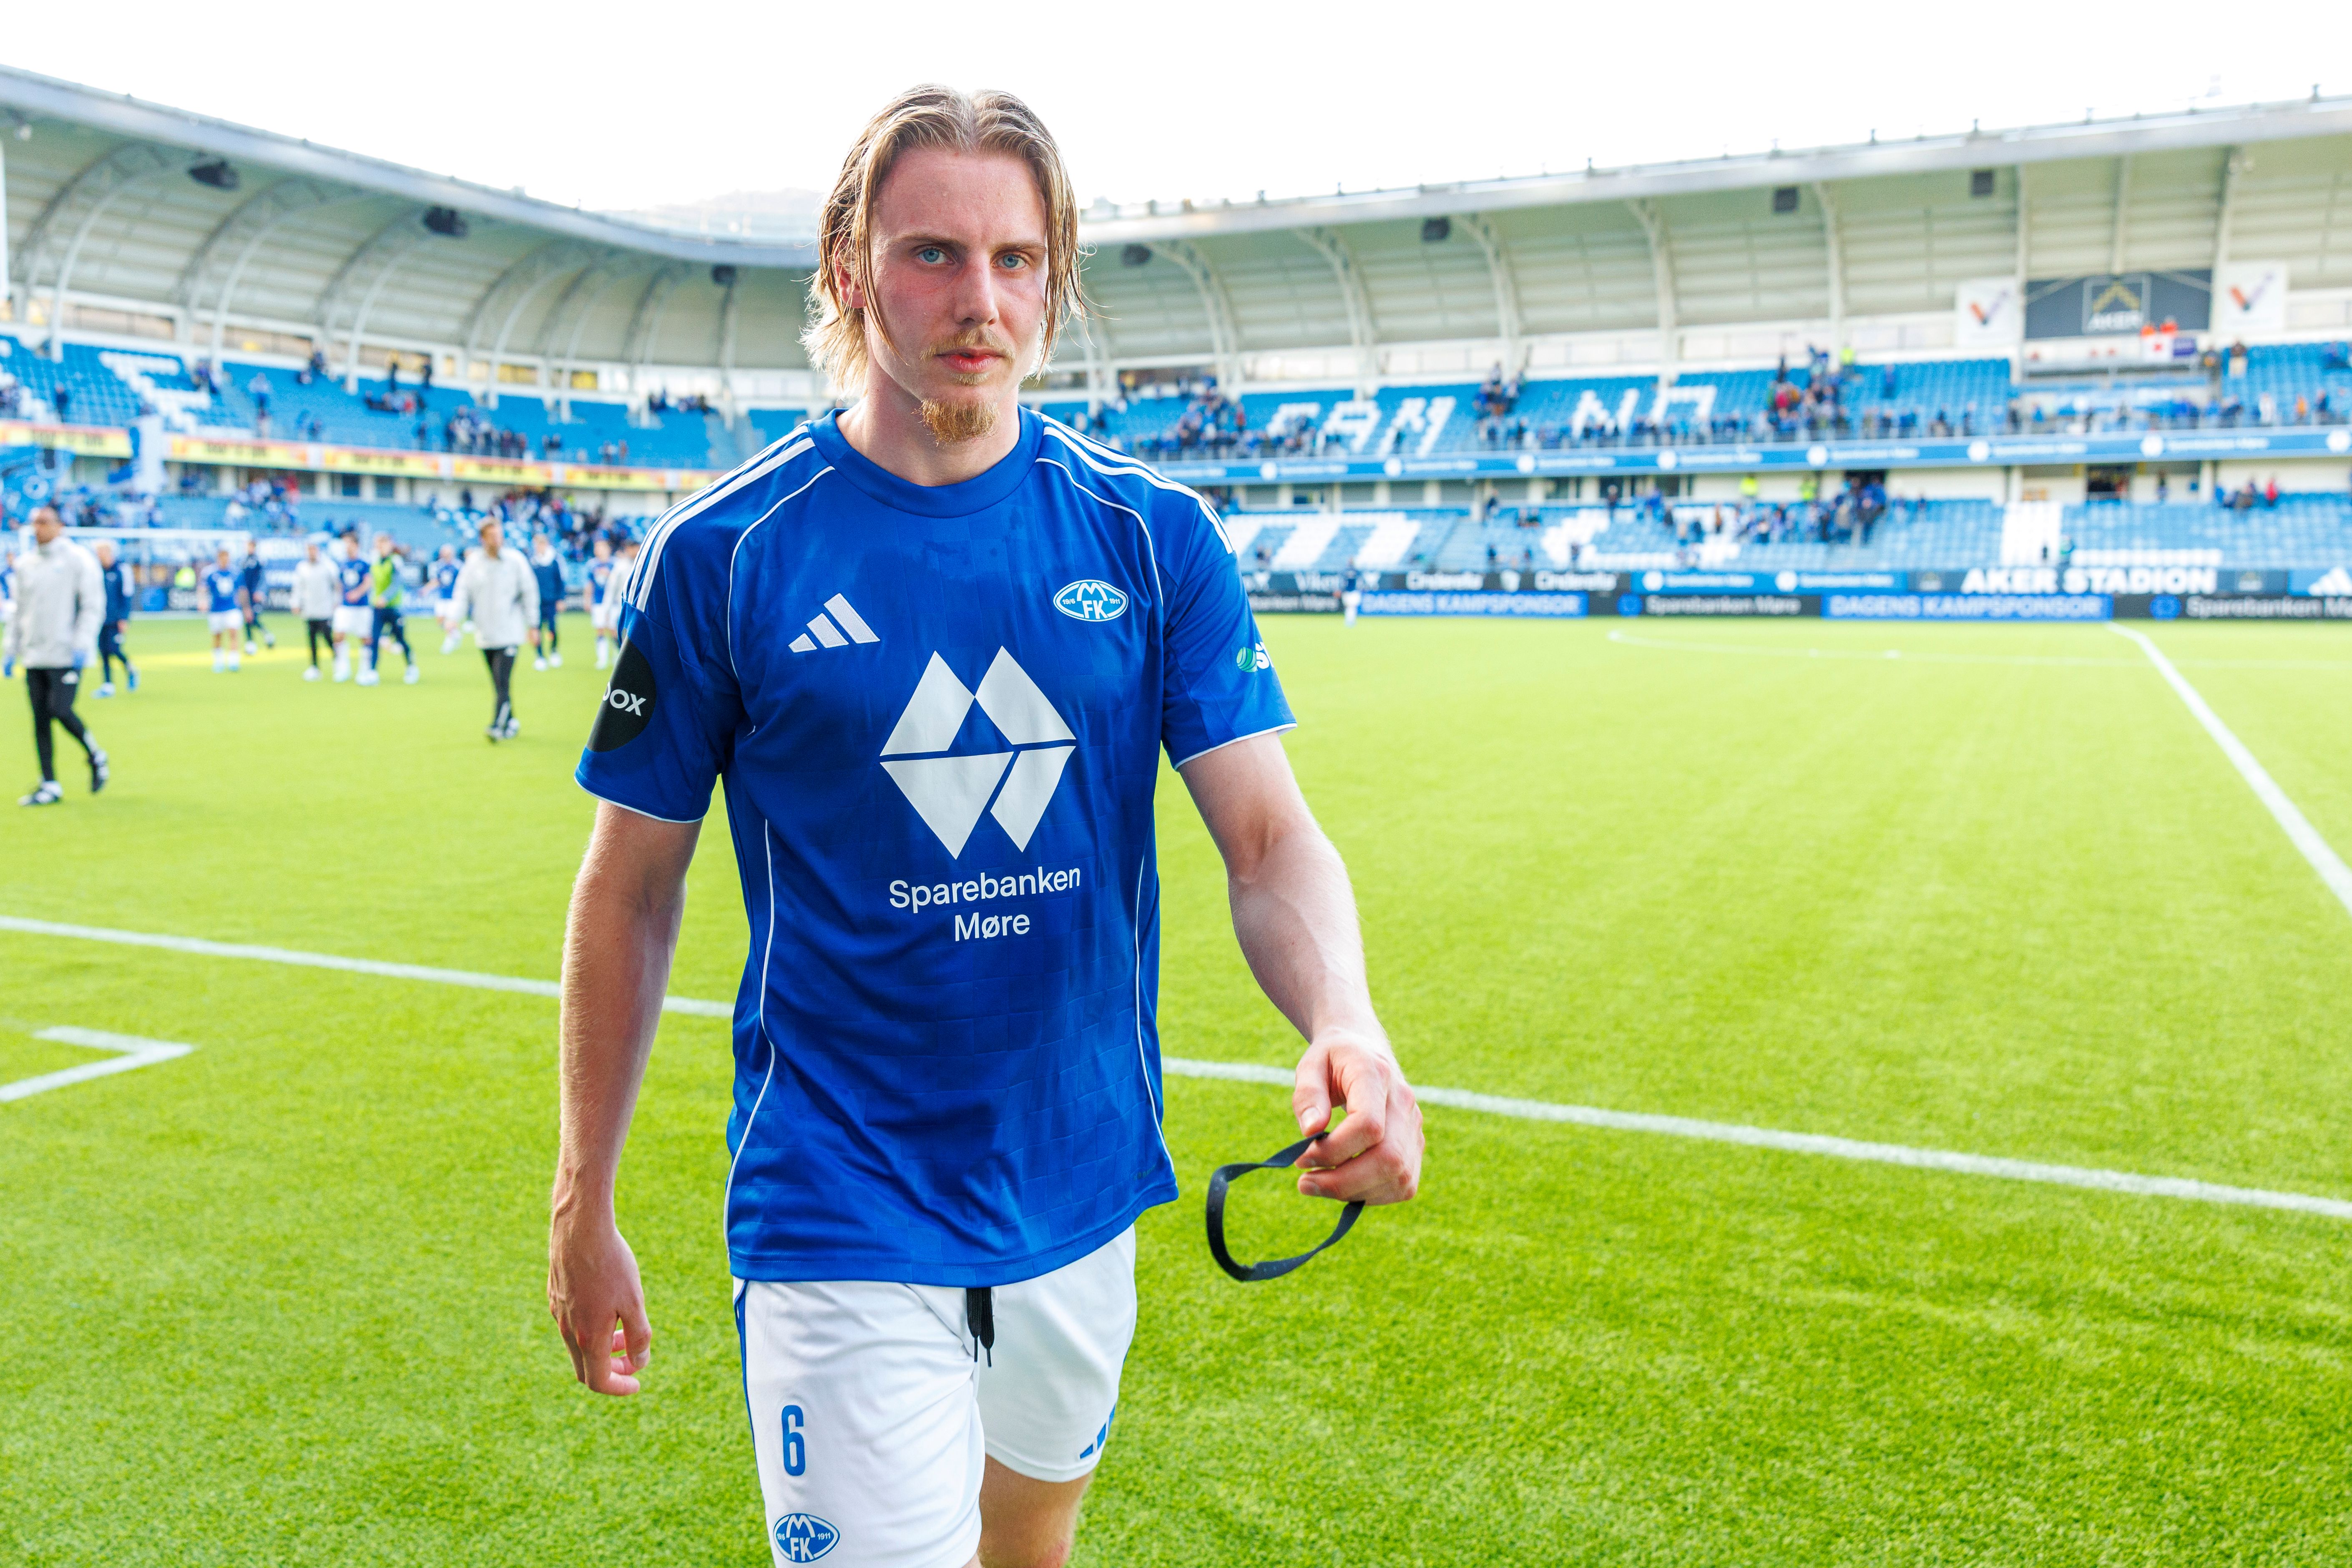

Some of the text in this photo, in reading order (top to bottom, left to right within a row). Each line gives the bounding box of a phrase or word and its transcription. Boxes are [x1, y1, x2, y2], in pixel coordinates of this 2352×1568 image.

[1960, 568, 2058, 593] AKER
[2063, 568, 2217, 594] STADION
[1362, 593, 1434, 613] DAGENS
[1829, 595, 2103, 617] DAGENS KAMPSPONSOR
[2186, 596, 2322, 618] Sparebanken
[889, 866, 1081, 914] Sparebanken
[955, 912, 1030, 941] Møre
[781, 1405, 805, 1476] 6
